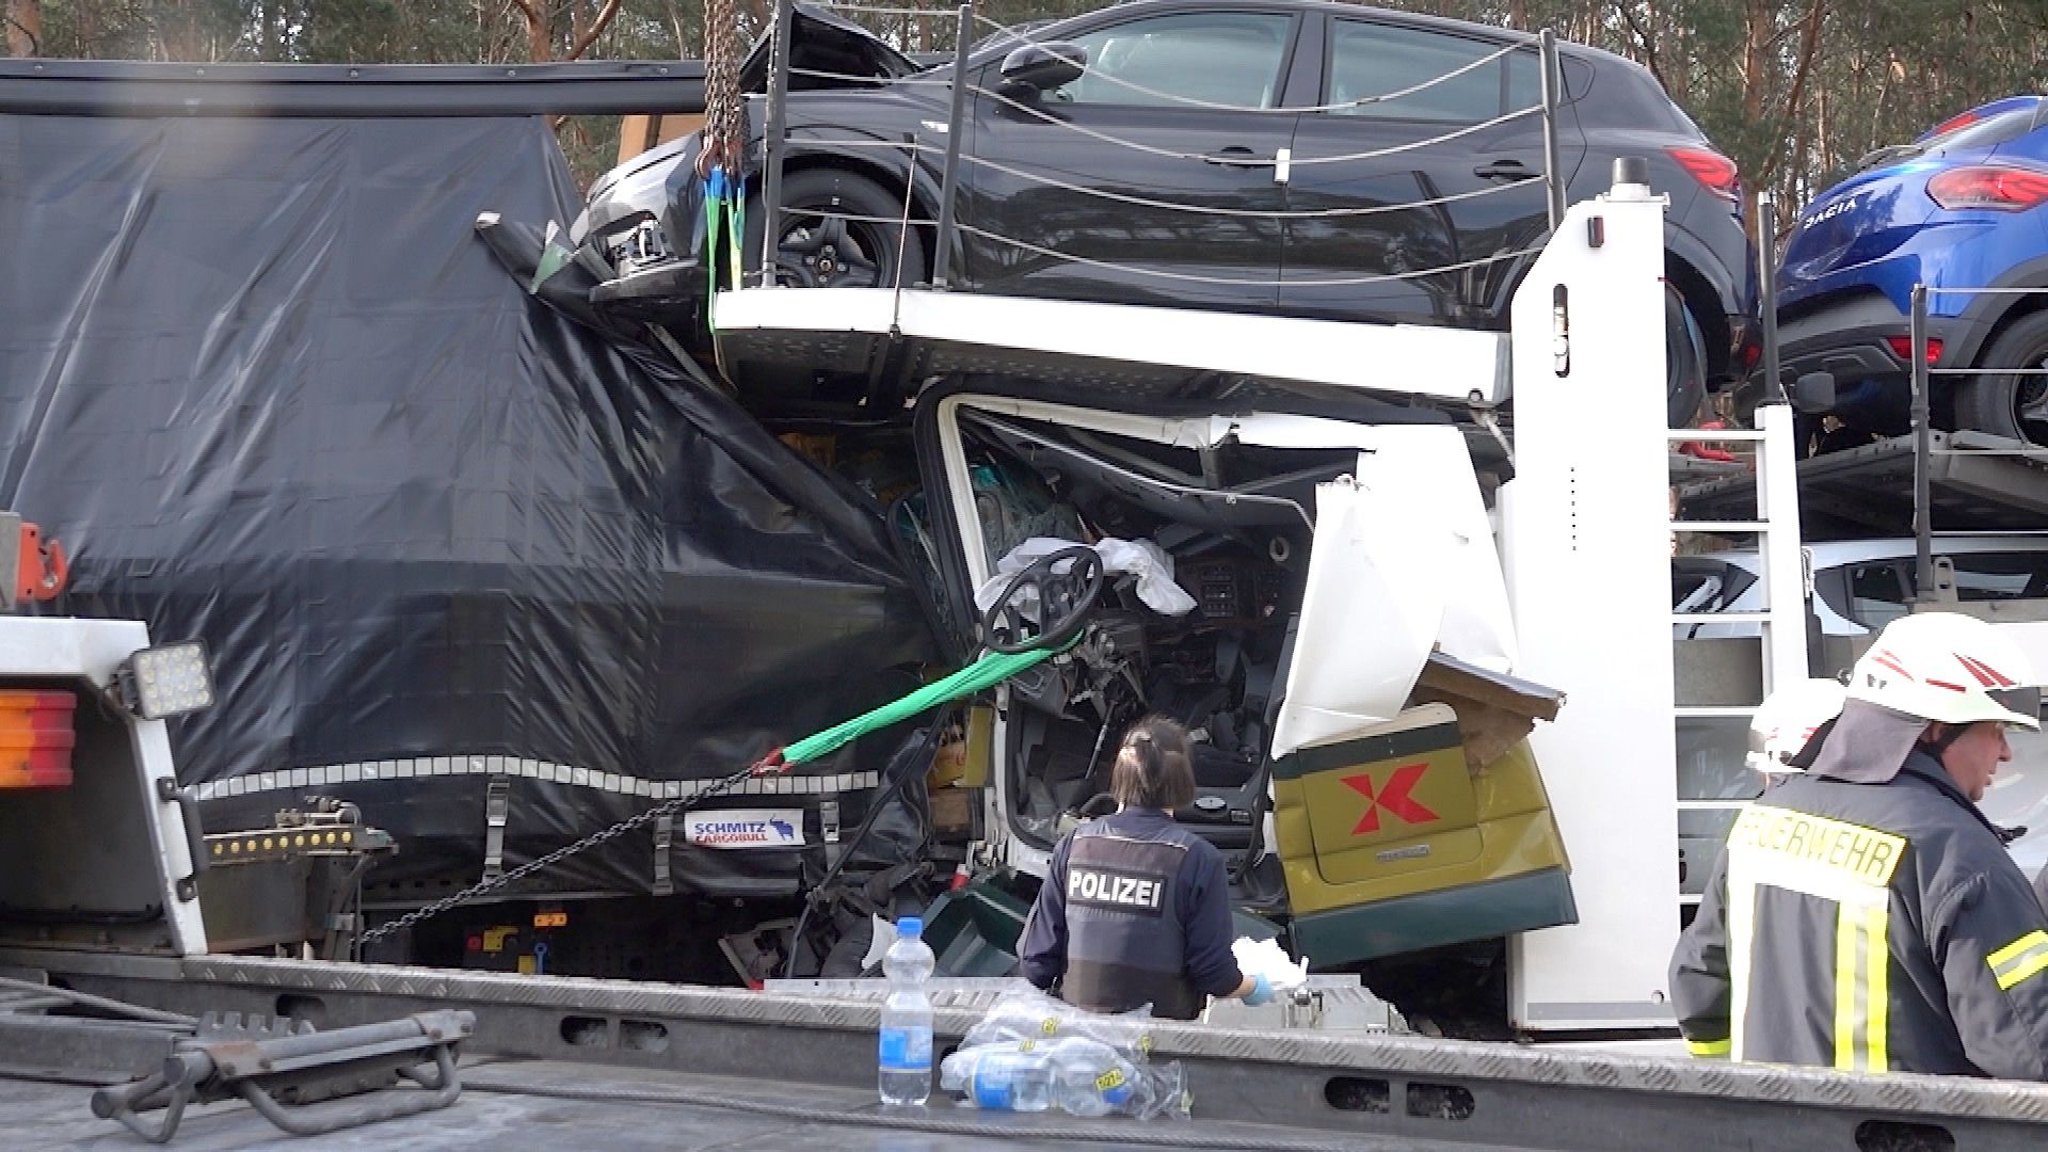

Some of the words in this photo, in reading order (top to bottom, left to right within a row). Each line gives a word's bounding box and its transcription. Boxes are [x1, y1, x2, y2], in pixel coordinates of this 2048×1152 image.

[1803, 198, 1857, 229] DACIA
[695, 822, 766, 834] SCHMITZ
[695, 833, 768, 844] CARGOBULL
[1068, 869, 1161, 908] POLIZEI
